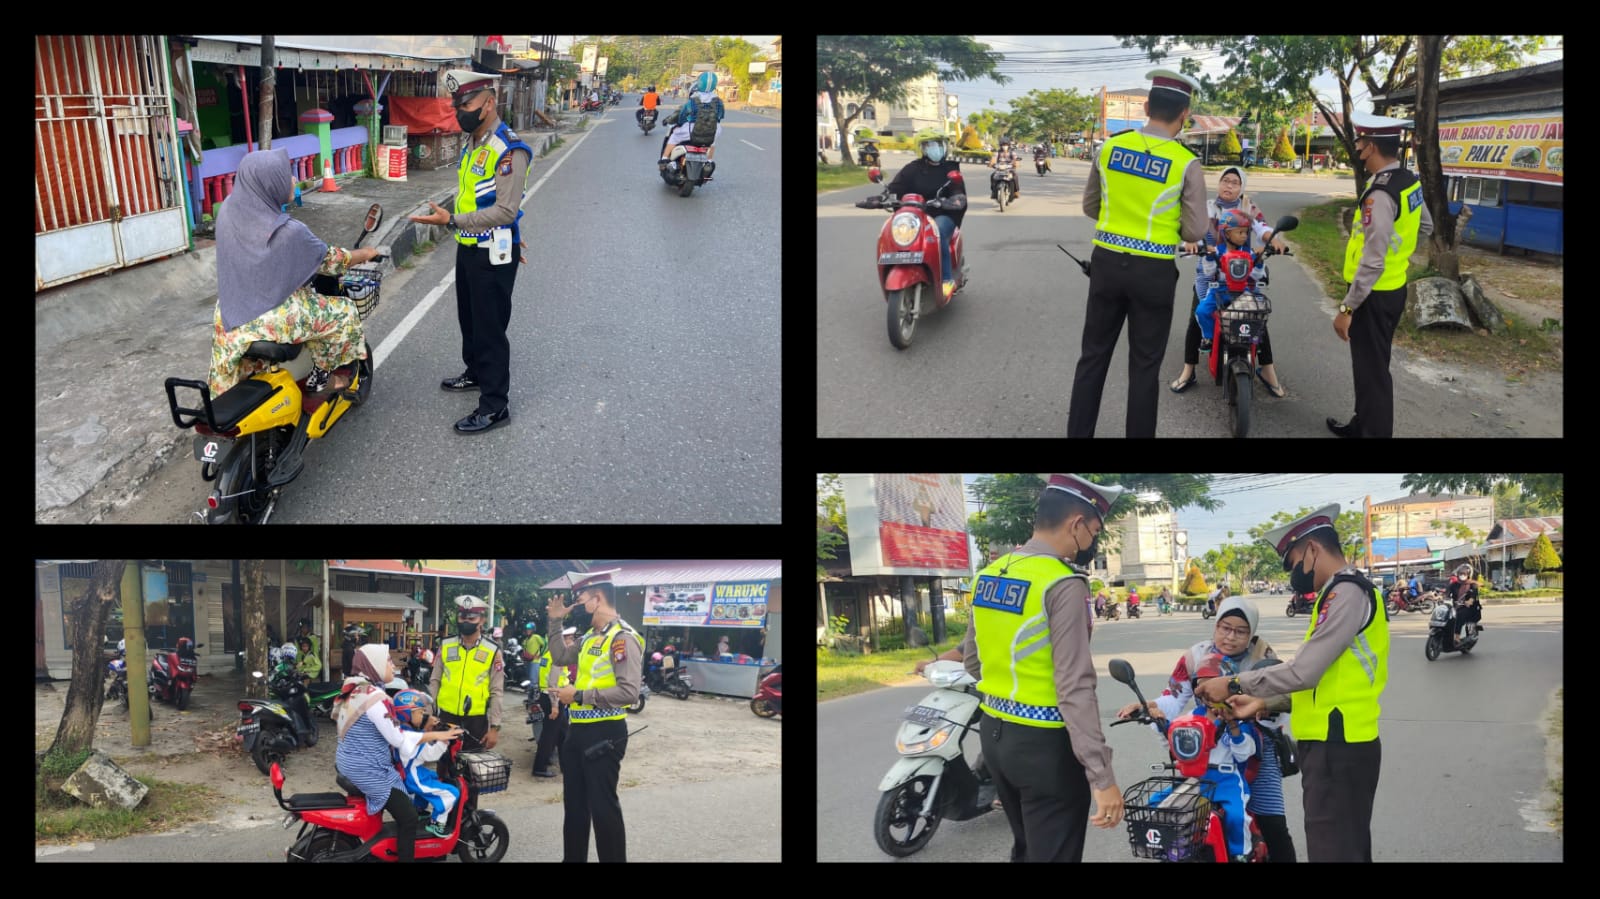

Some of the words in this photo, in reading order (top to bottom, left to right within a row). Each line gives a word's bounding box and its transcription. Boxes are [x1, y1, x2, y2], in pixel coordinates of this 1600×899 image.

[1461, 126, 1496, 140] BAKSO
[1496, 128, 1504, 139] &
[1506, 124, 1541, 139] SOTO
[1465, 145, 1490, 162] PAK
[1490, 145, 1508, 162] LE
[1110, 150, 1168, 178] POLISI
[715, 583, 768, 598] WARUNG
[974, 580, 1027, 608] POLISI
